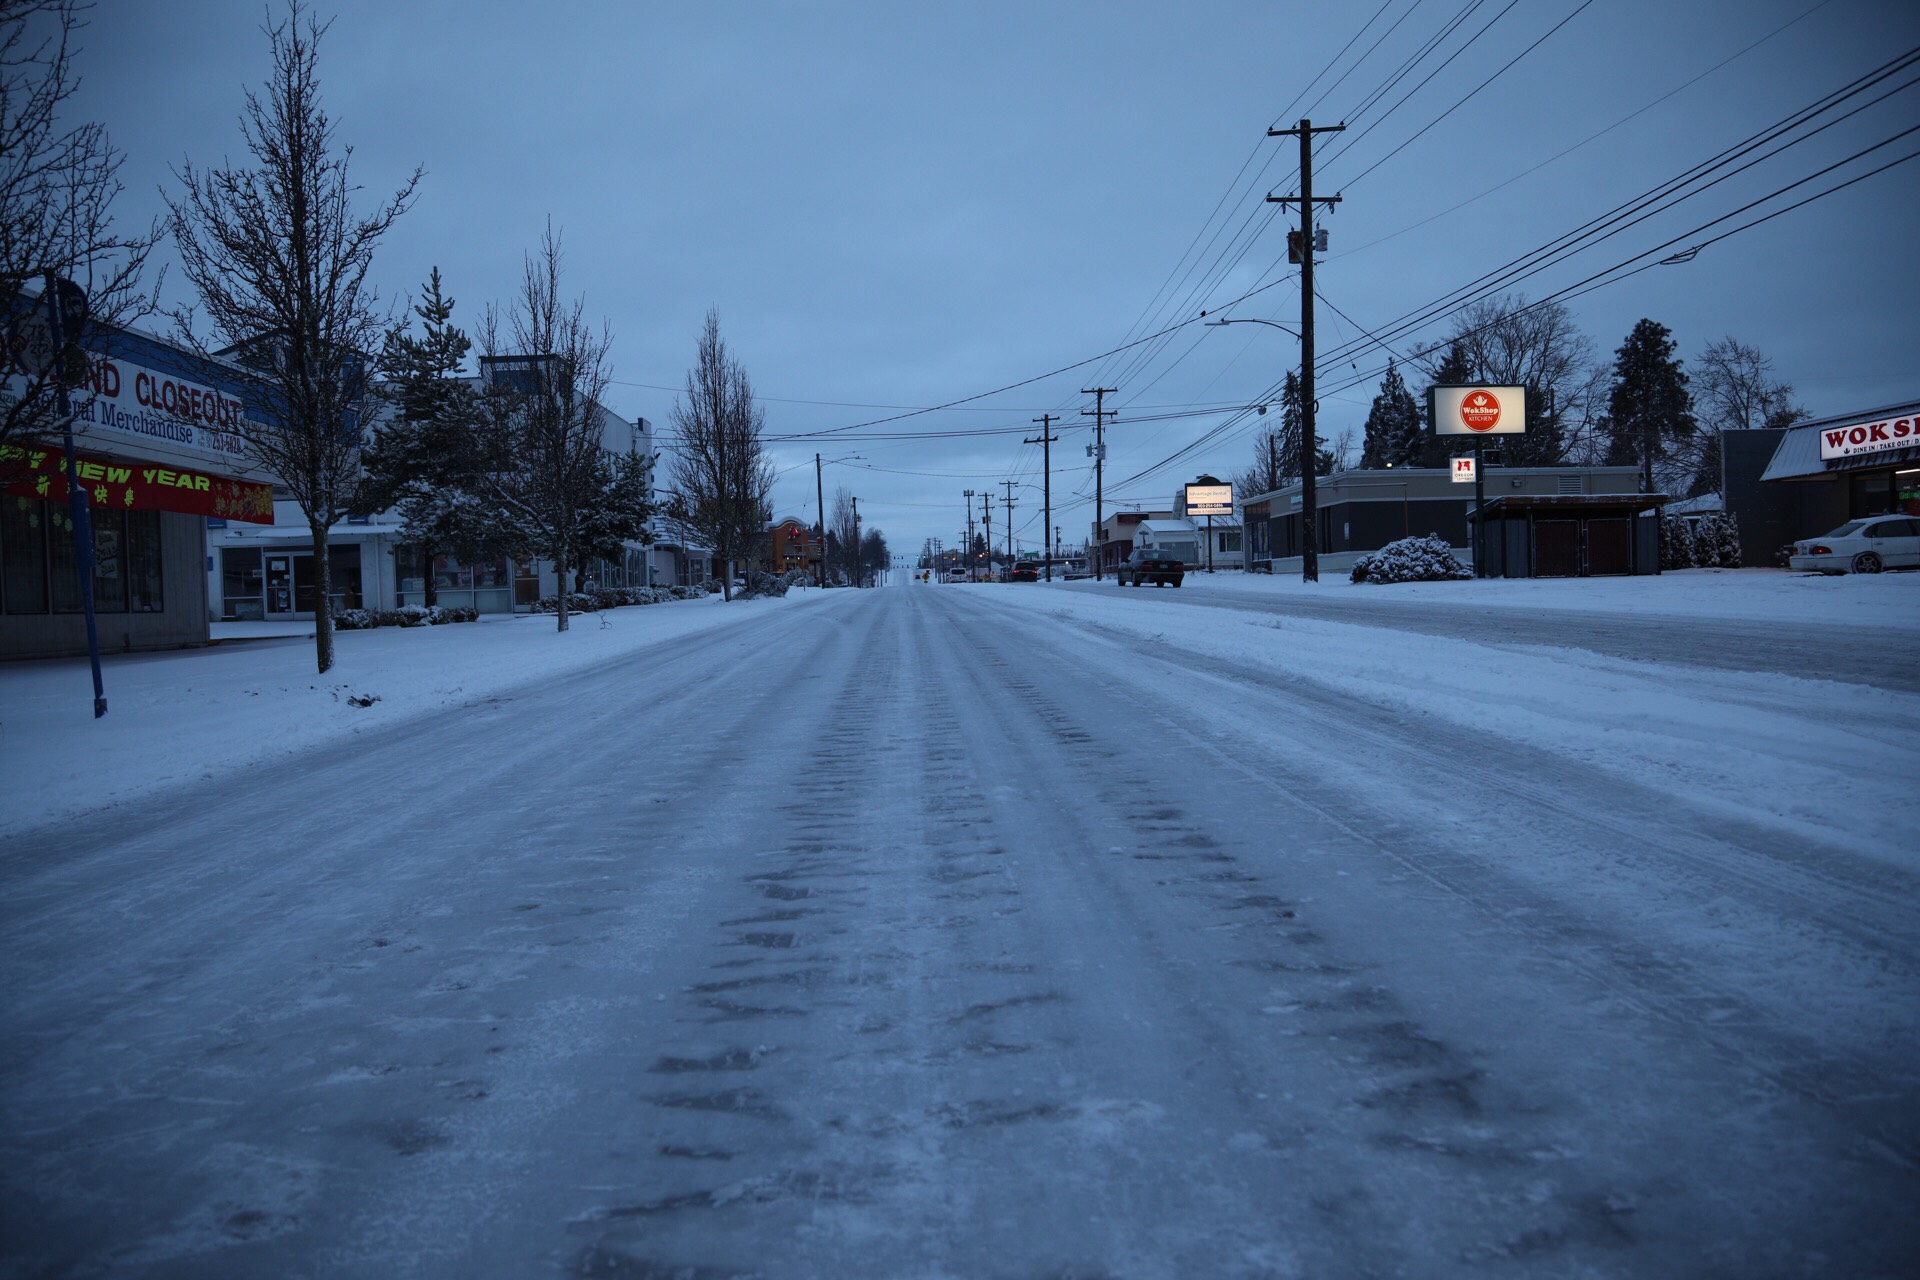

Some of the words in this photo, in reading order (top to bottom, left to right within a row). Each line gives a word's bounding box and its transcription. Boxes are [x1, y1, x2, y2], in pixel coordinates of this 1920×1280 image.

[136, 372, 241, 427] CLOSEOUT
[1463, 407, 1499, 415] WokShop
[101, 401, 193, 444] Merchandise
[1880, 441, 1895, 450] TAKE
[142, 469, 210, 491] YEAR
